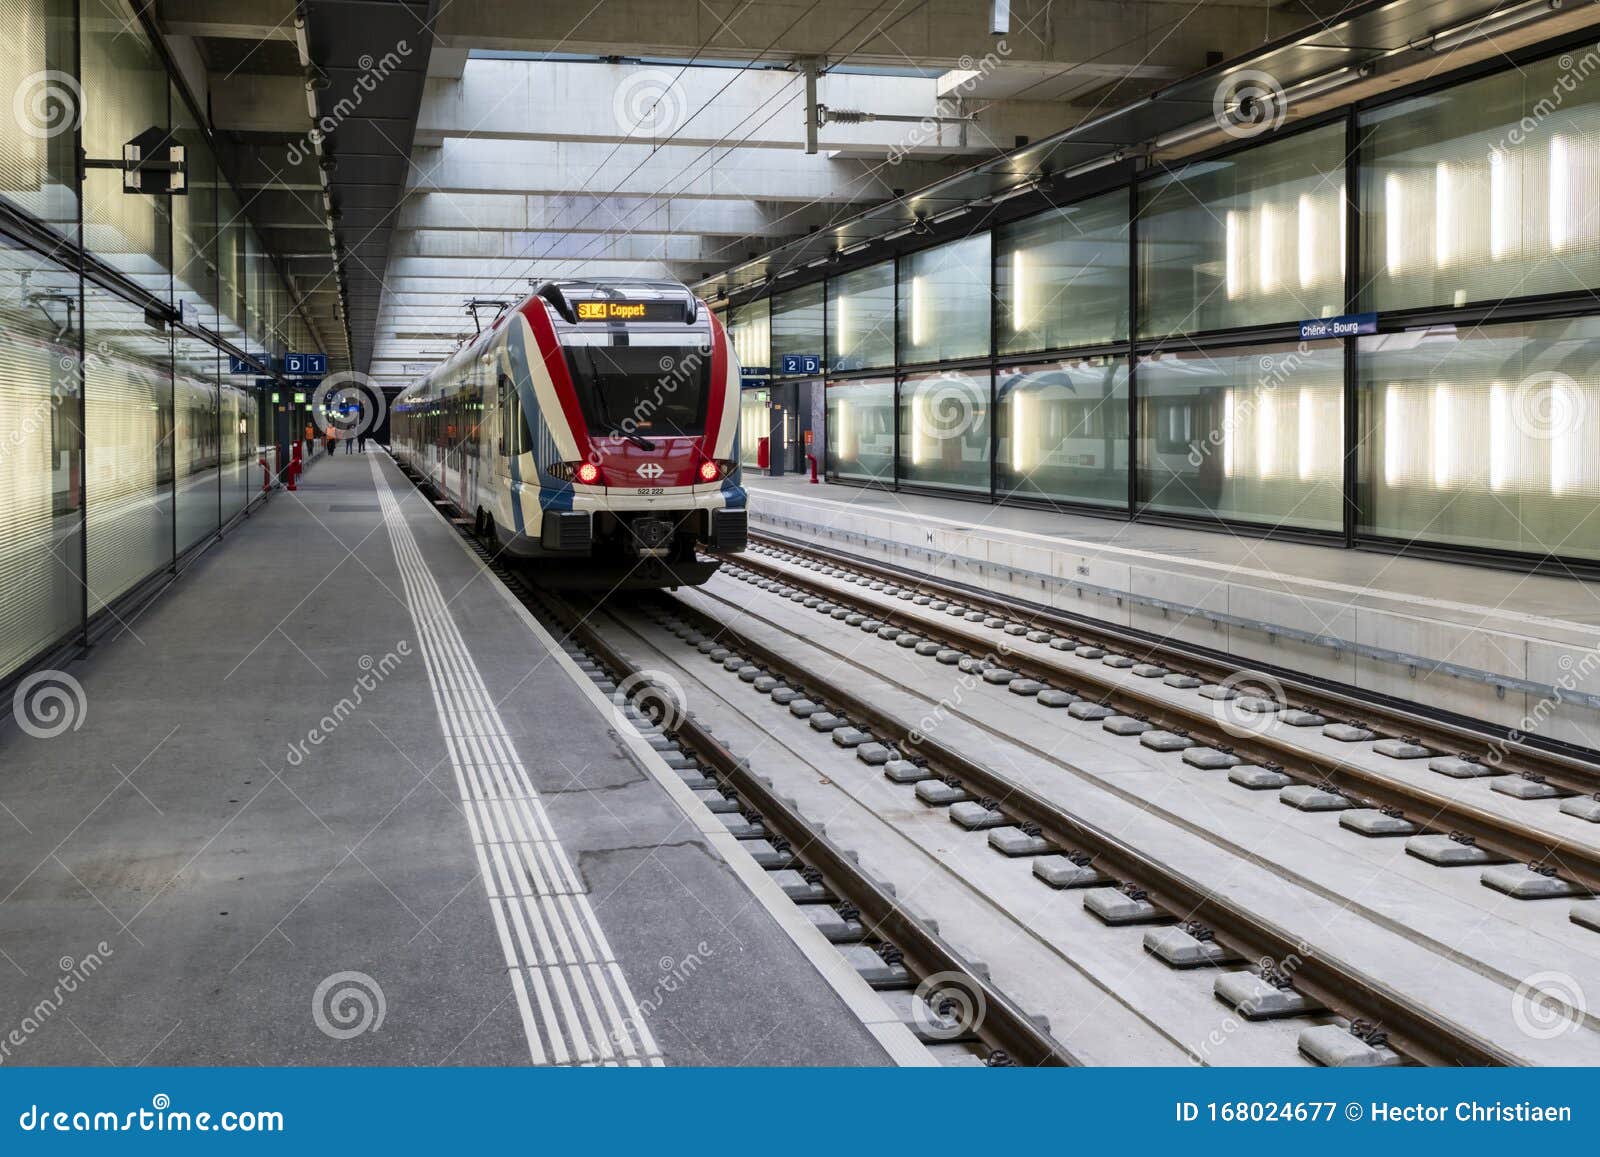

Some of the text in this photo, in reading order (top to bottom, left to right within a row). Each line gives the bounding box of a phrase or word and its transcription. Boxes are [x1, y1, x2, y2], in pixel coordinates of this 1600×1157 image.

[579, 303, 645, 318] SL4 Coppet
[1301, 325, 1326, 336] Chêne
[1333, 322, 1358, 334] Bourg
[290, 360, 319, 371] D 1
[788, 360, 815, 371] 2 D
